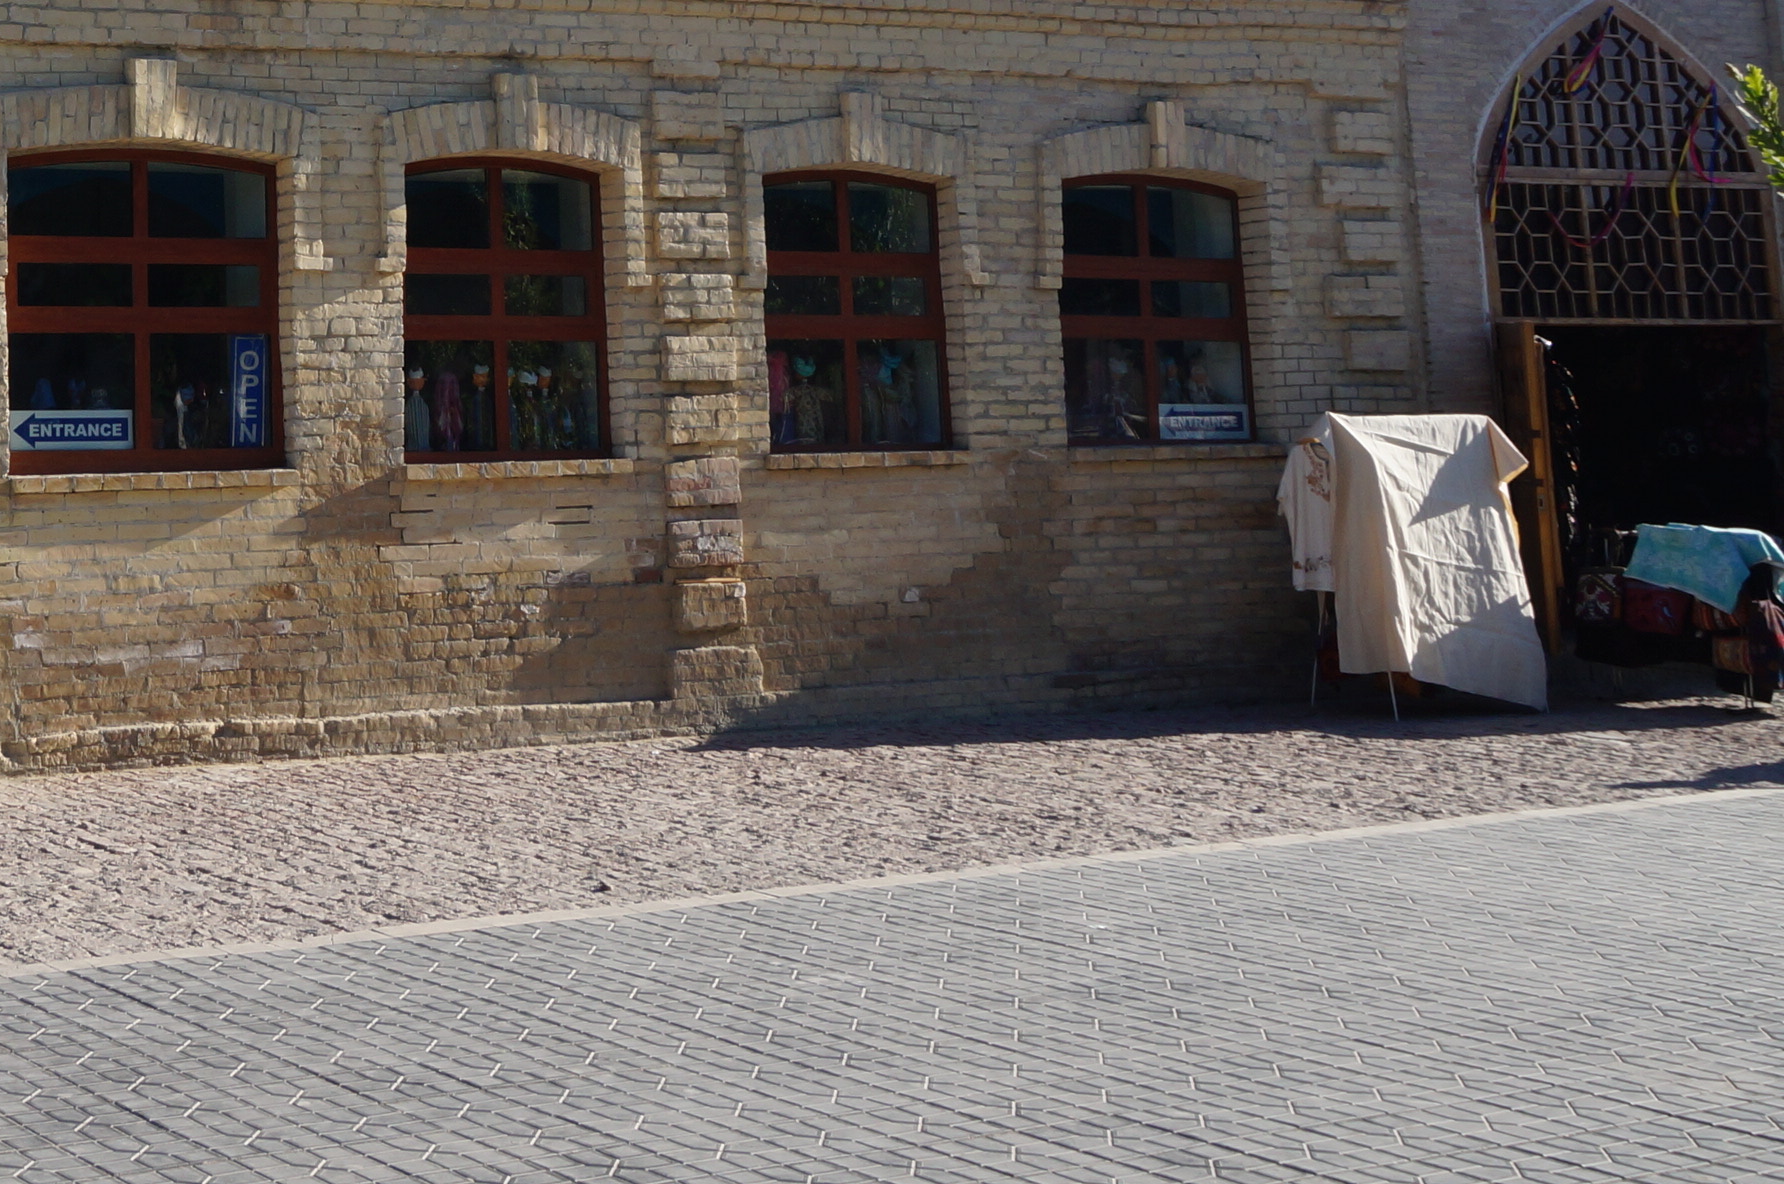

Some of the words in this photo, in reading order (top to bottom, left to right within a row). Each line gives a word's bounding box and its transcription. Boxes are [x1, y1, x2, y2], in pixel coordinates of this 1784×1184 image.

[238, 350, 259, 444] OPEN
[1170, 415, 1238, 428] ENTRANCE
[28, 422, 123, 438] ENTRANCE
